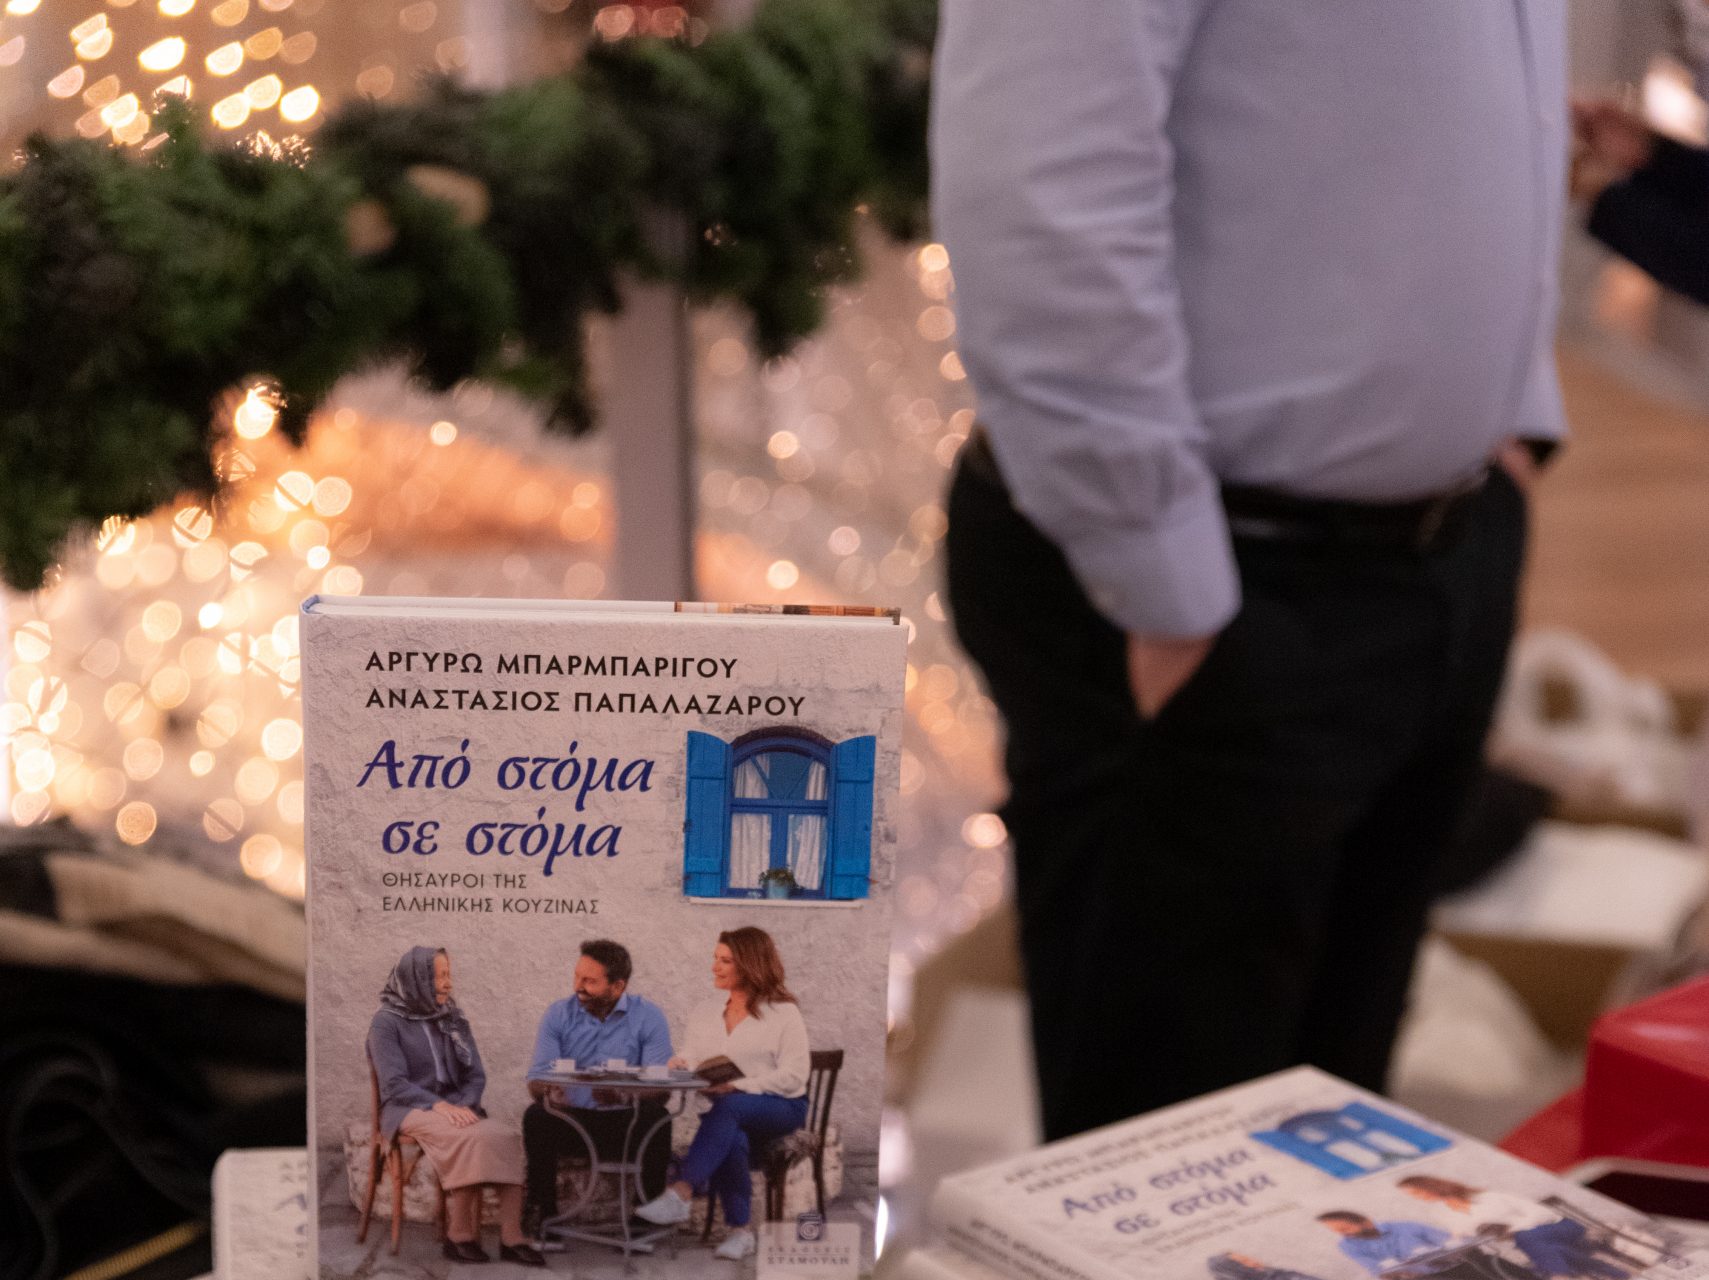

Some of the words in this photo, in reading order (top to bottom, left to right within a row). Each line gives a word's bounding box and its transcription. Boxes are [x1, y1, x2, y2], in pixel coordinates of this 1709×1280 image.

[366, 650, 483, 674] ΑΡΓΥΡΩ
[497, 653, 738, 679] ΜΠΑΡΜΠΑΡΙΓΟΥ
[366, 688, 560, 713] ΑΝΑΣΤΑΣΙΟΣ
[574, 691, 805, 717] ΠΑΠΑΛΑΖΑΡΟΥ
[357, 739, 472, 790] Από
[497, 741, 655, 812] στόμα
[382, 820, 438, 856] σε
[466, 807, 622, 877] στόμα
[382, 871, 486, 890] ΘΗΣΑΥΡΟΙ
[491, 872, 527, 890] ΤΗΣ
[382, 895, 494, 913] ΕΛΛΗΝΙΚΗΣ
[502, 897, 600, 915] ΚΟΥΖΙΝΑΣ
[1149, 1148, 1253, 1190] στόμα
[1114, 1212, 1160, 1235] σε
[1169, 1173, 1276, 1215] στόμα
